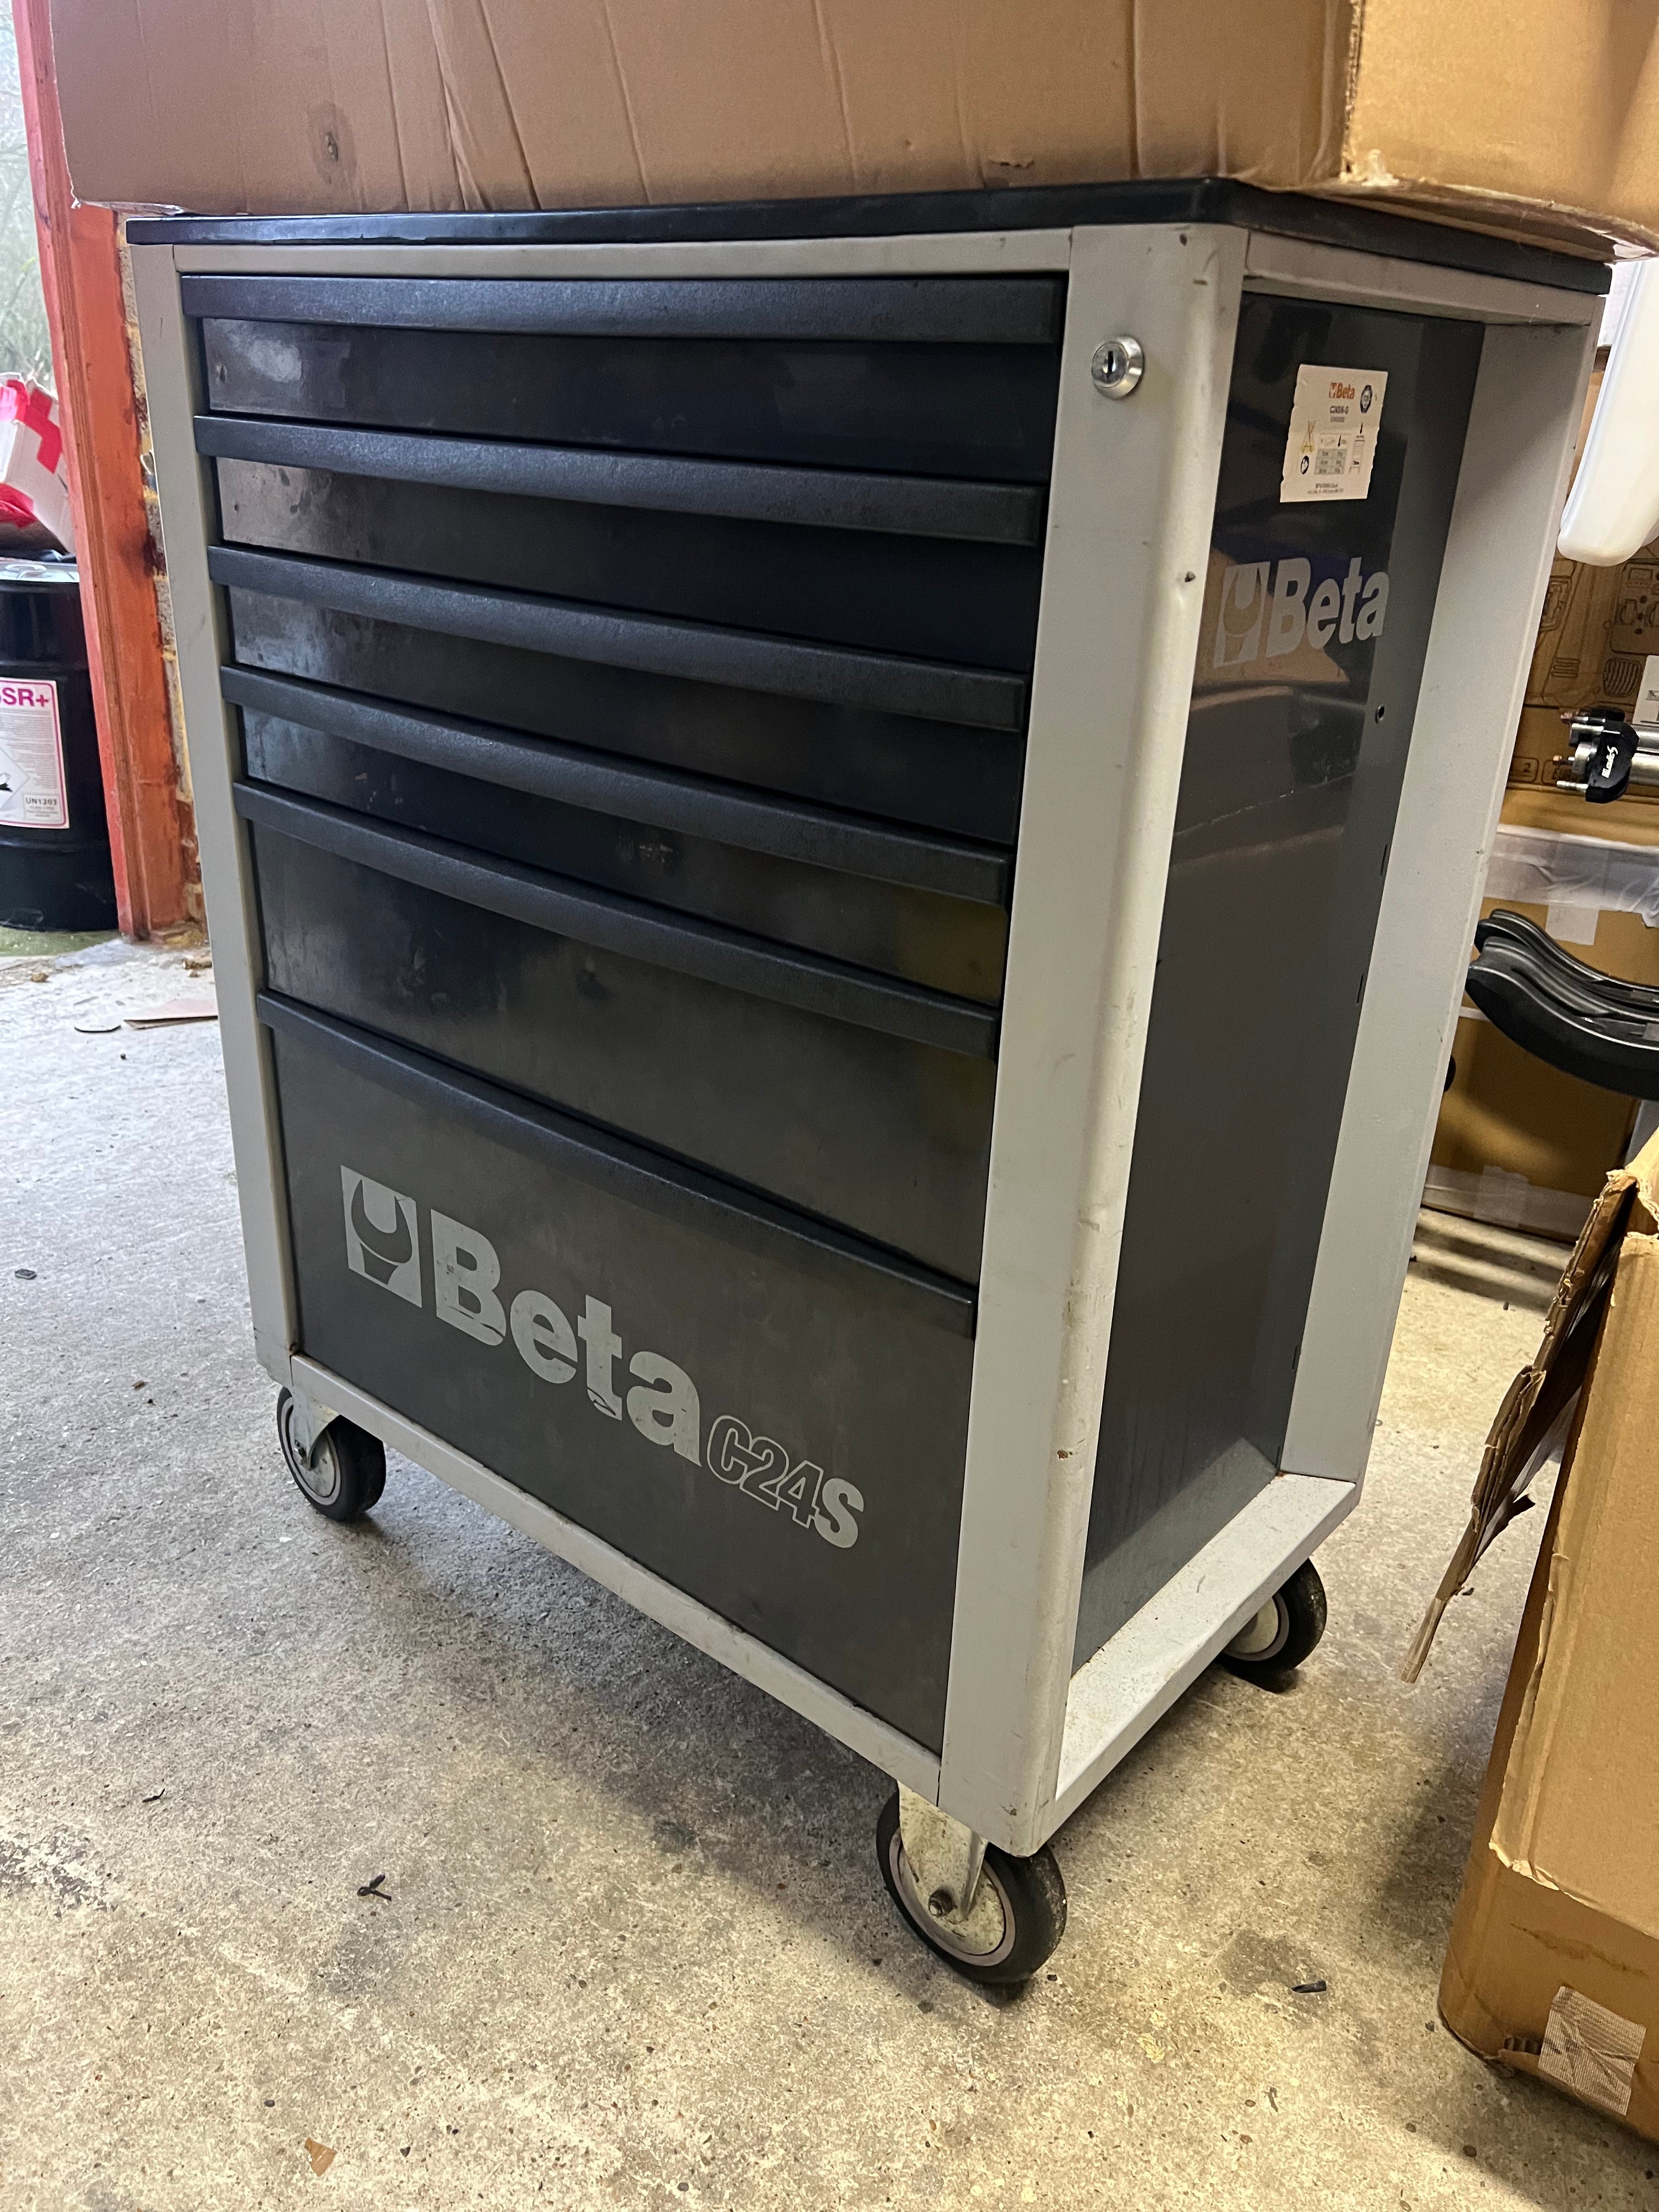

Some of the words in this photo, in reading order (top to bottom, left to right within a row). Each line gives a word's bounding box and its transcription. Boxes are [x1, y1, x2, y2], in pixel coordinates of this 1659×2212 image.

[1336, 382, 1355, 400] Beta
[1266, 556, 1389, 658] Beta
[0, 687, 49, 707] SR+
[431, 1209, 702, 1467] Beta
[707, 1414, 864, 1549] C24S
